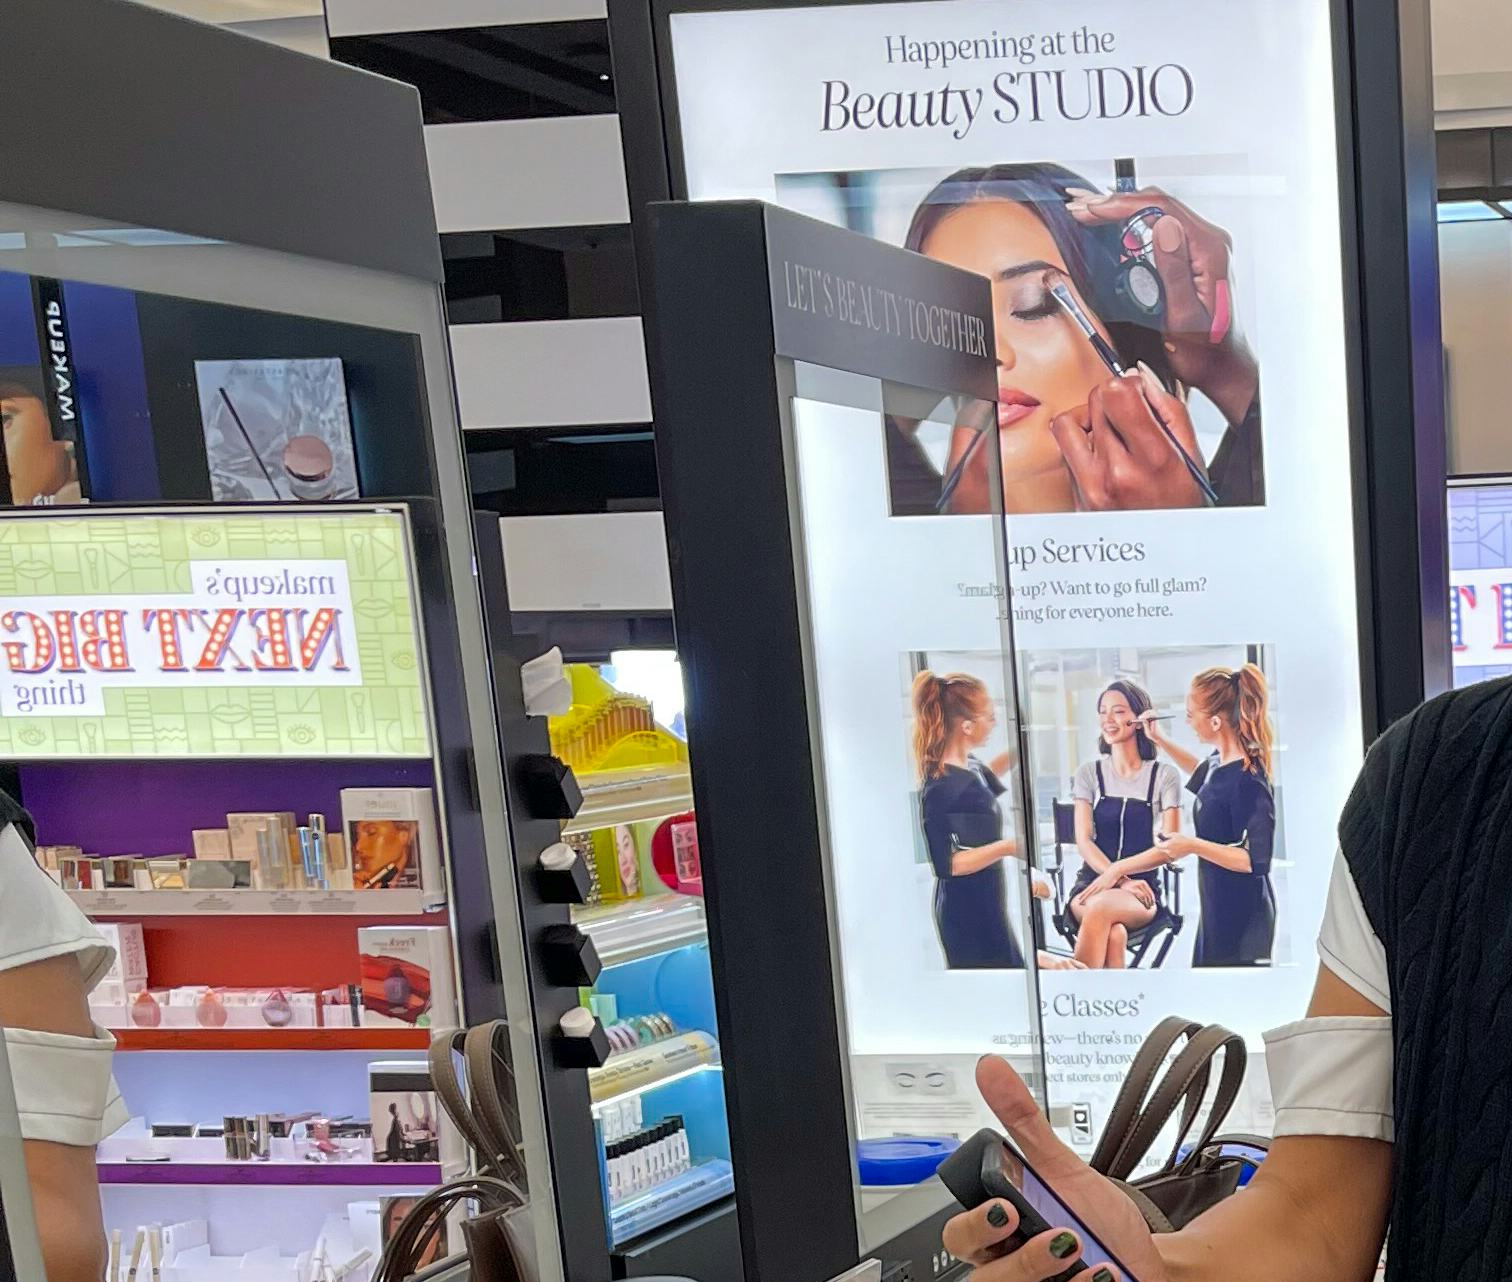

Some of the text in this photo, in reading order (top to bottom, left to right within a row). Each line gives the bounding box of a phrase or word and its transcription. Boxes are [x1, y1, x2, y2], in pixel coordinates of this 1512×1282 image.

[884, 26, 1116, 69] Happening at the
[819, 63, 1195, 140] Beauty STUDIO
[784, 261, 988, 358] LET'S BEAUTY TOGETHER
[1042, 537, 1145, 564] Services
[1050, 580, 1092, 596] Want
[1095, 581, 1110, 595] to
[1113, 583, 1132, 597] go
[1135, 578, 1159, 594] full
[1162, 577, 1207, 597] glam?
[1046, 604, 1066, 620] for
[1069, 605, 1134, 622] everyone
[1137, 603, 1173, 617] here.
[1124, 1034, 1143, 1045] no
[1047, 1052, 1093, 1067] beauty
[1067, 1072, 1101, 1083] stores
